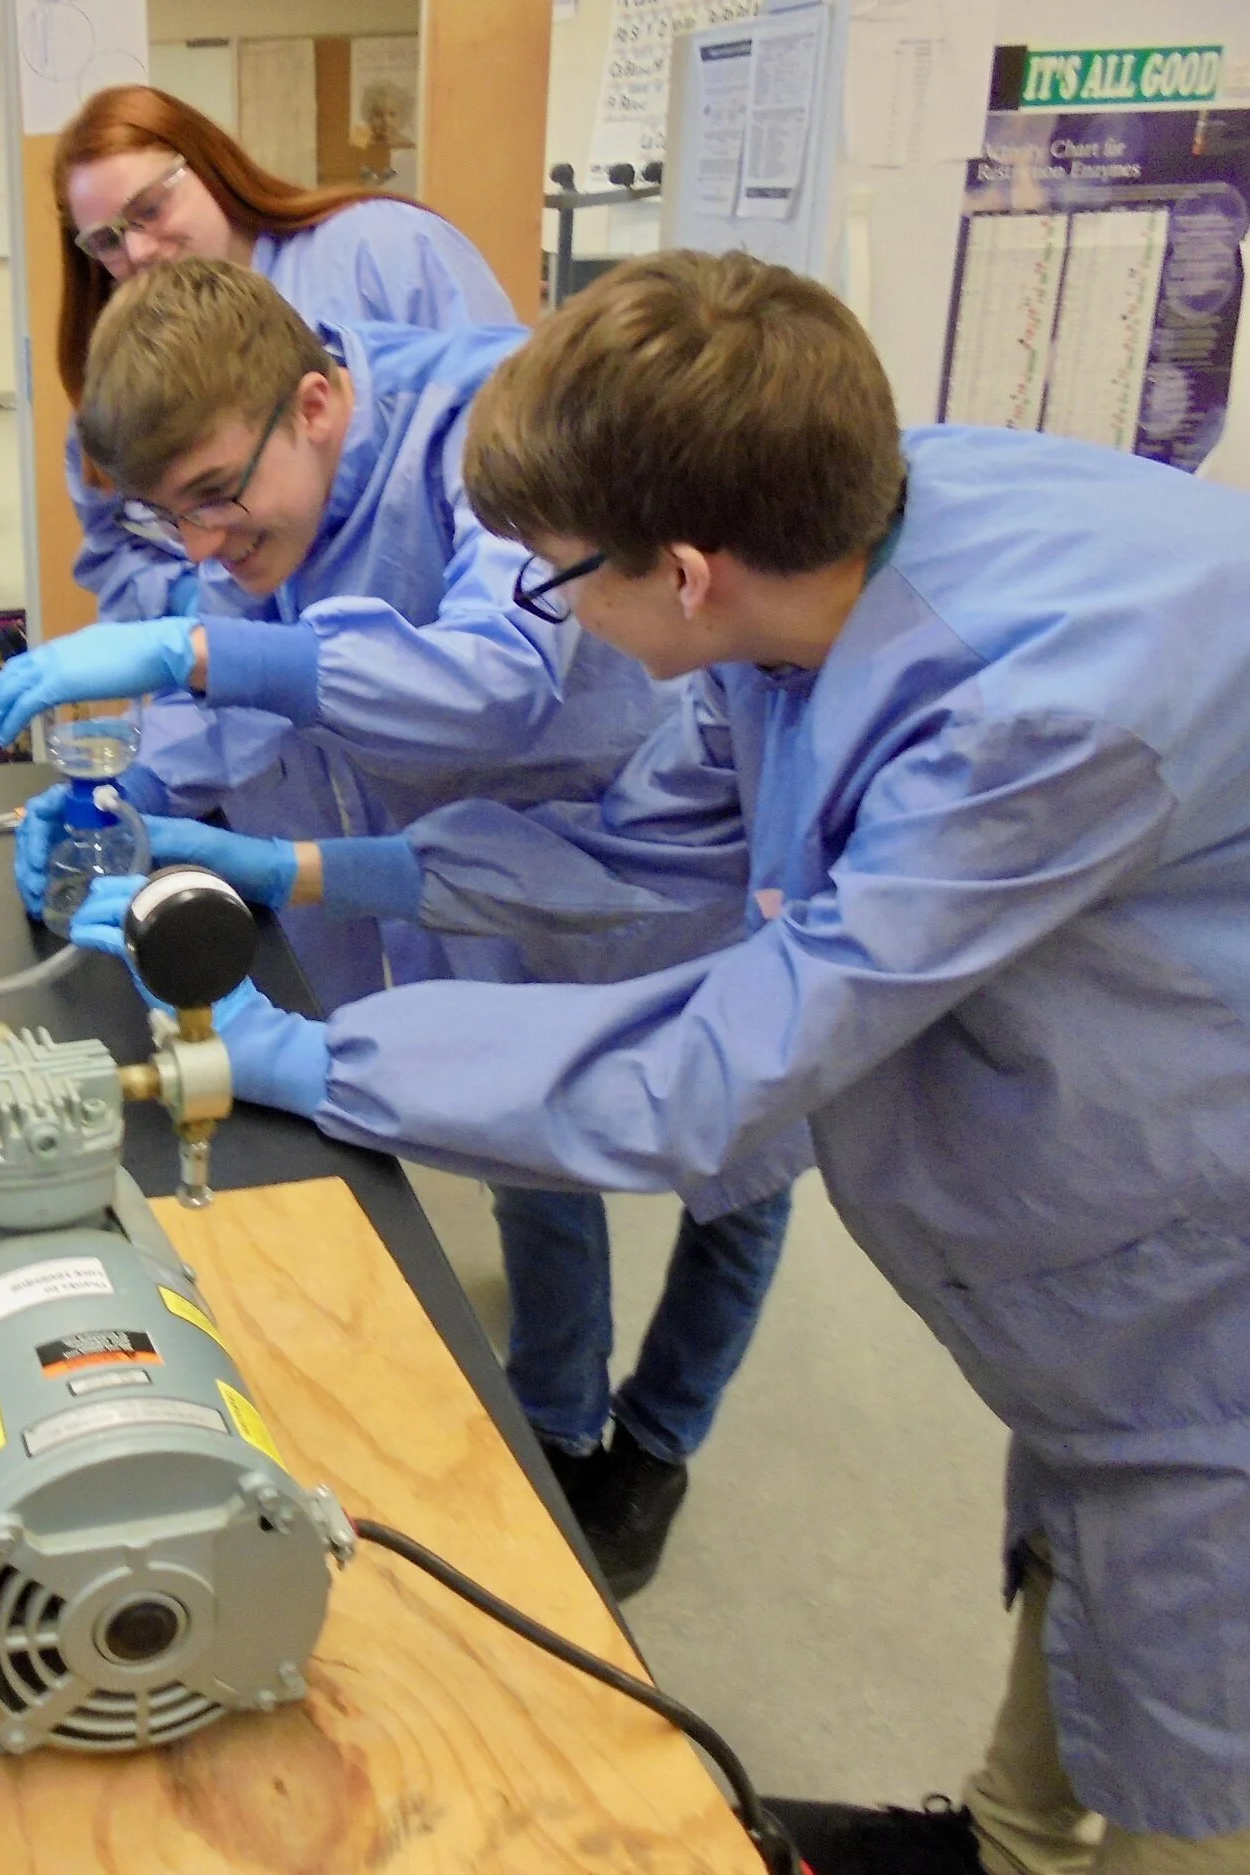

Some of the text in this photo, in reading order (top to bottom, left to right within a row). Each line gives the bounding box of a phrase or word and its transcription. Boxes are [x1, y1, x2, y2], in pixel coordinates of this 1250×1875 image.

[1024, 51, 1220, 101] IT'S ALL GOOD
